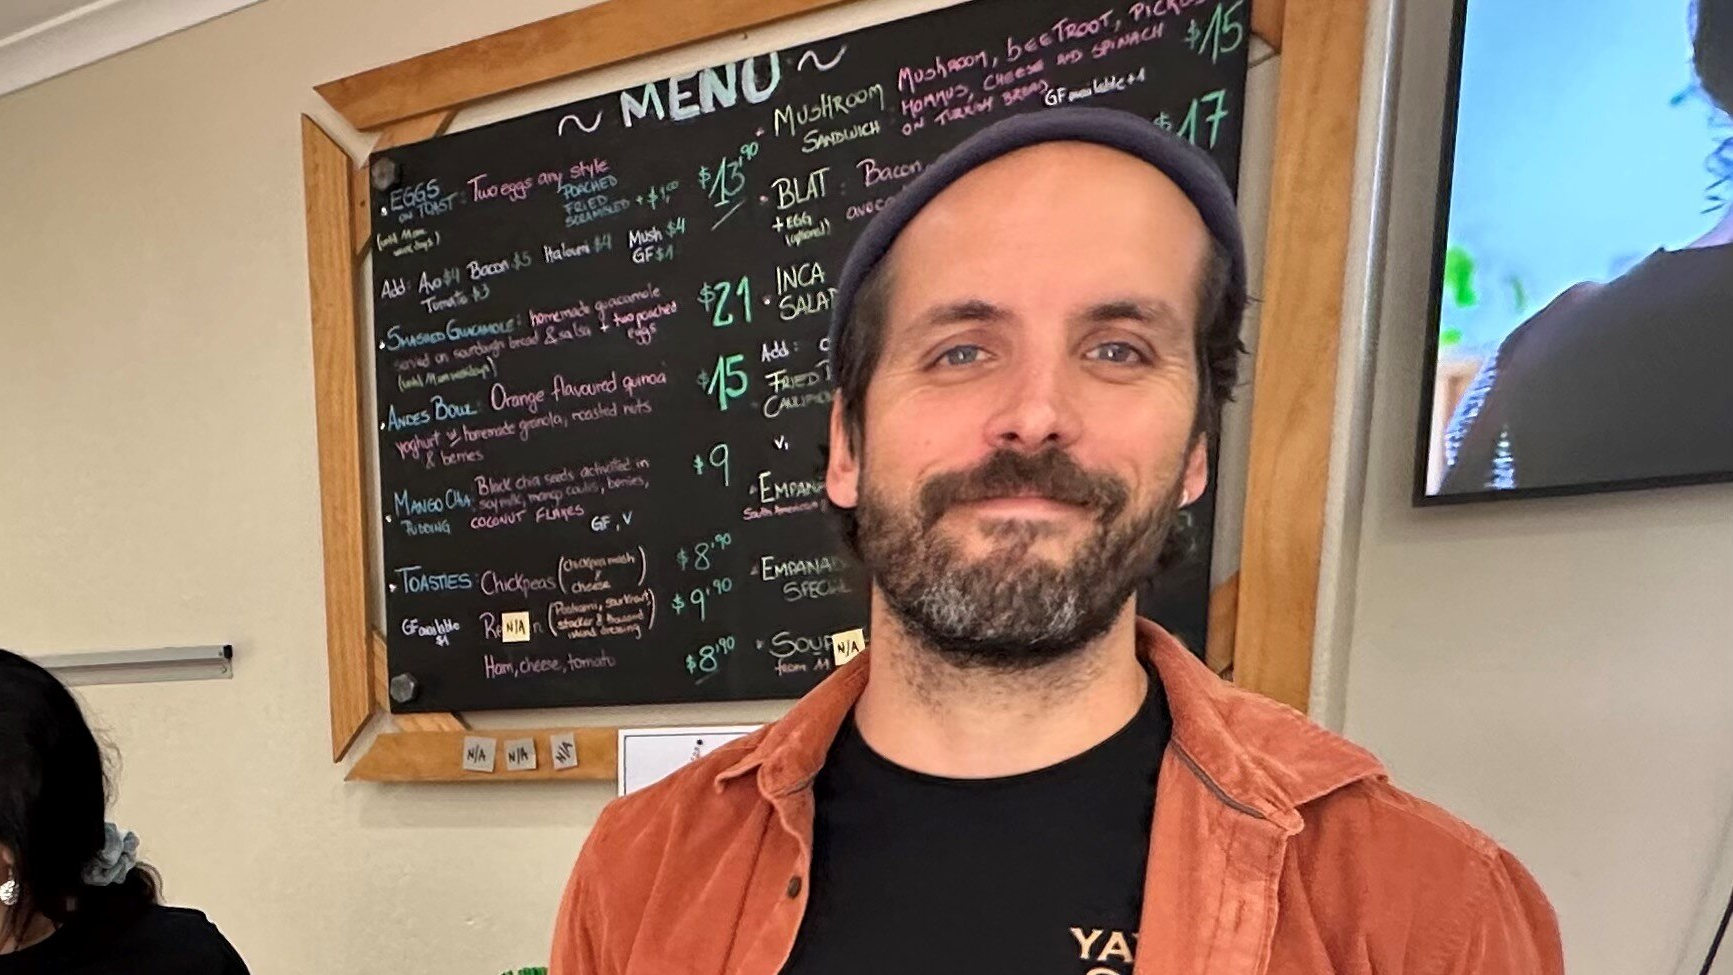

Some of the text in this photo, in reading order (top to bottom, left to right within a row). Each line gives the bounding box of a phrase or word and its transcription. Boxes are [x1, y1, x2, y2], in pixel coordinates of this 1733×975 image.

[619, 51, 782, 128] MENU
[801, 120, 881, 153] SANDWICH
[1091, 22, 1164, 60] SPINACH
[772, 83, 884, 137] MUSHROOM
[388, 157, 612, 212] EGGS Two eggs any style
[770, 166, 830, 211] BLAT
[563, 194, 609, 215] FRIED
[786, 212, 813, 229] EGG
[466, 258, 510, 281] Bacon
[628, 225, 664, 249] Mush
[776, 261, 826, 296] INCA
[387, 371, 668, 432] ANDES Orange flavoured quinoa
[395, 430, 440, 461] yoghurt
[440, 449, 485, 468] berries
[469, 510, 527, 531] COCONUT
[535, 503, 585, 524] FLAKES
[480, 569, 557, 599] Chickpeas
[505, 619, 527, 635] N/A
[568, 652, 617, 671] tomato
[836, 643, 860, 660] N/A
[466, 740, 573, 766] N/A N/A N/A
[1069, 926, 1140, 963] YA
